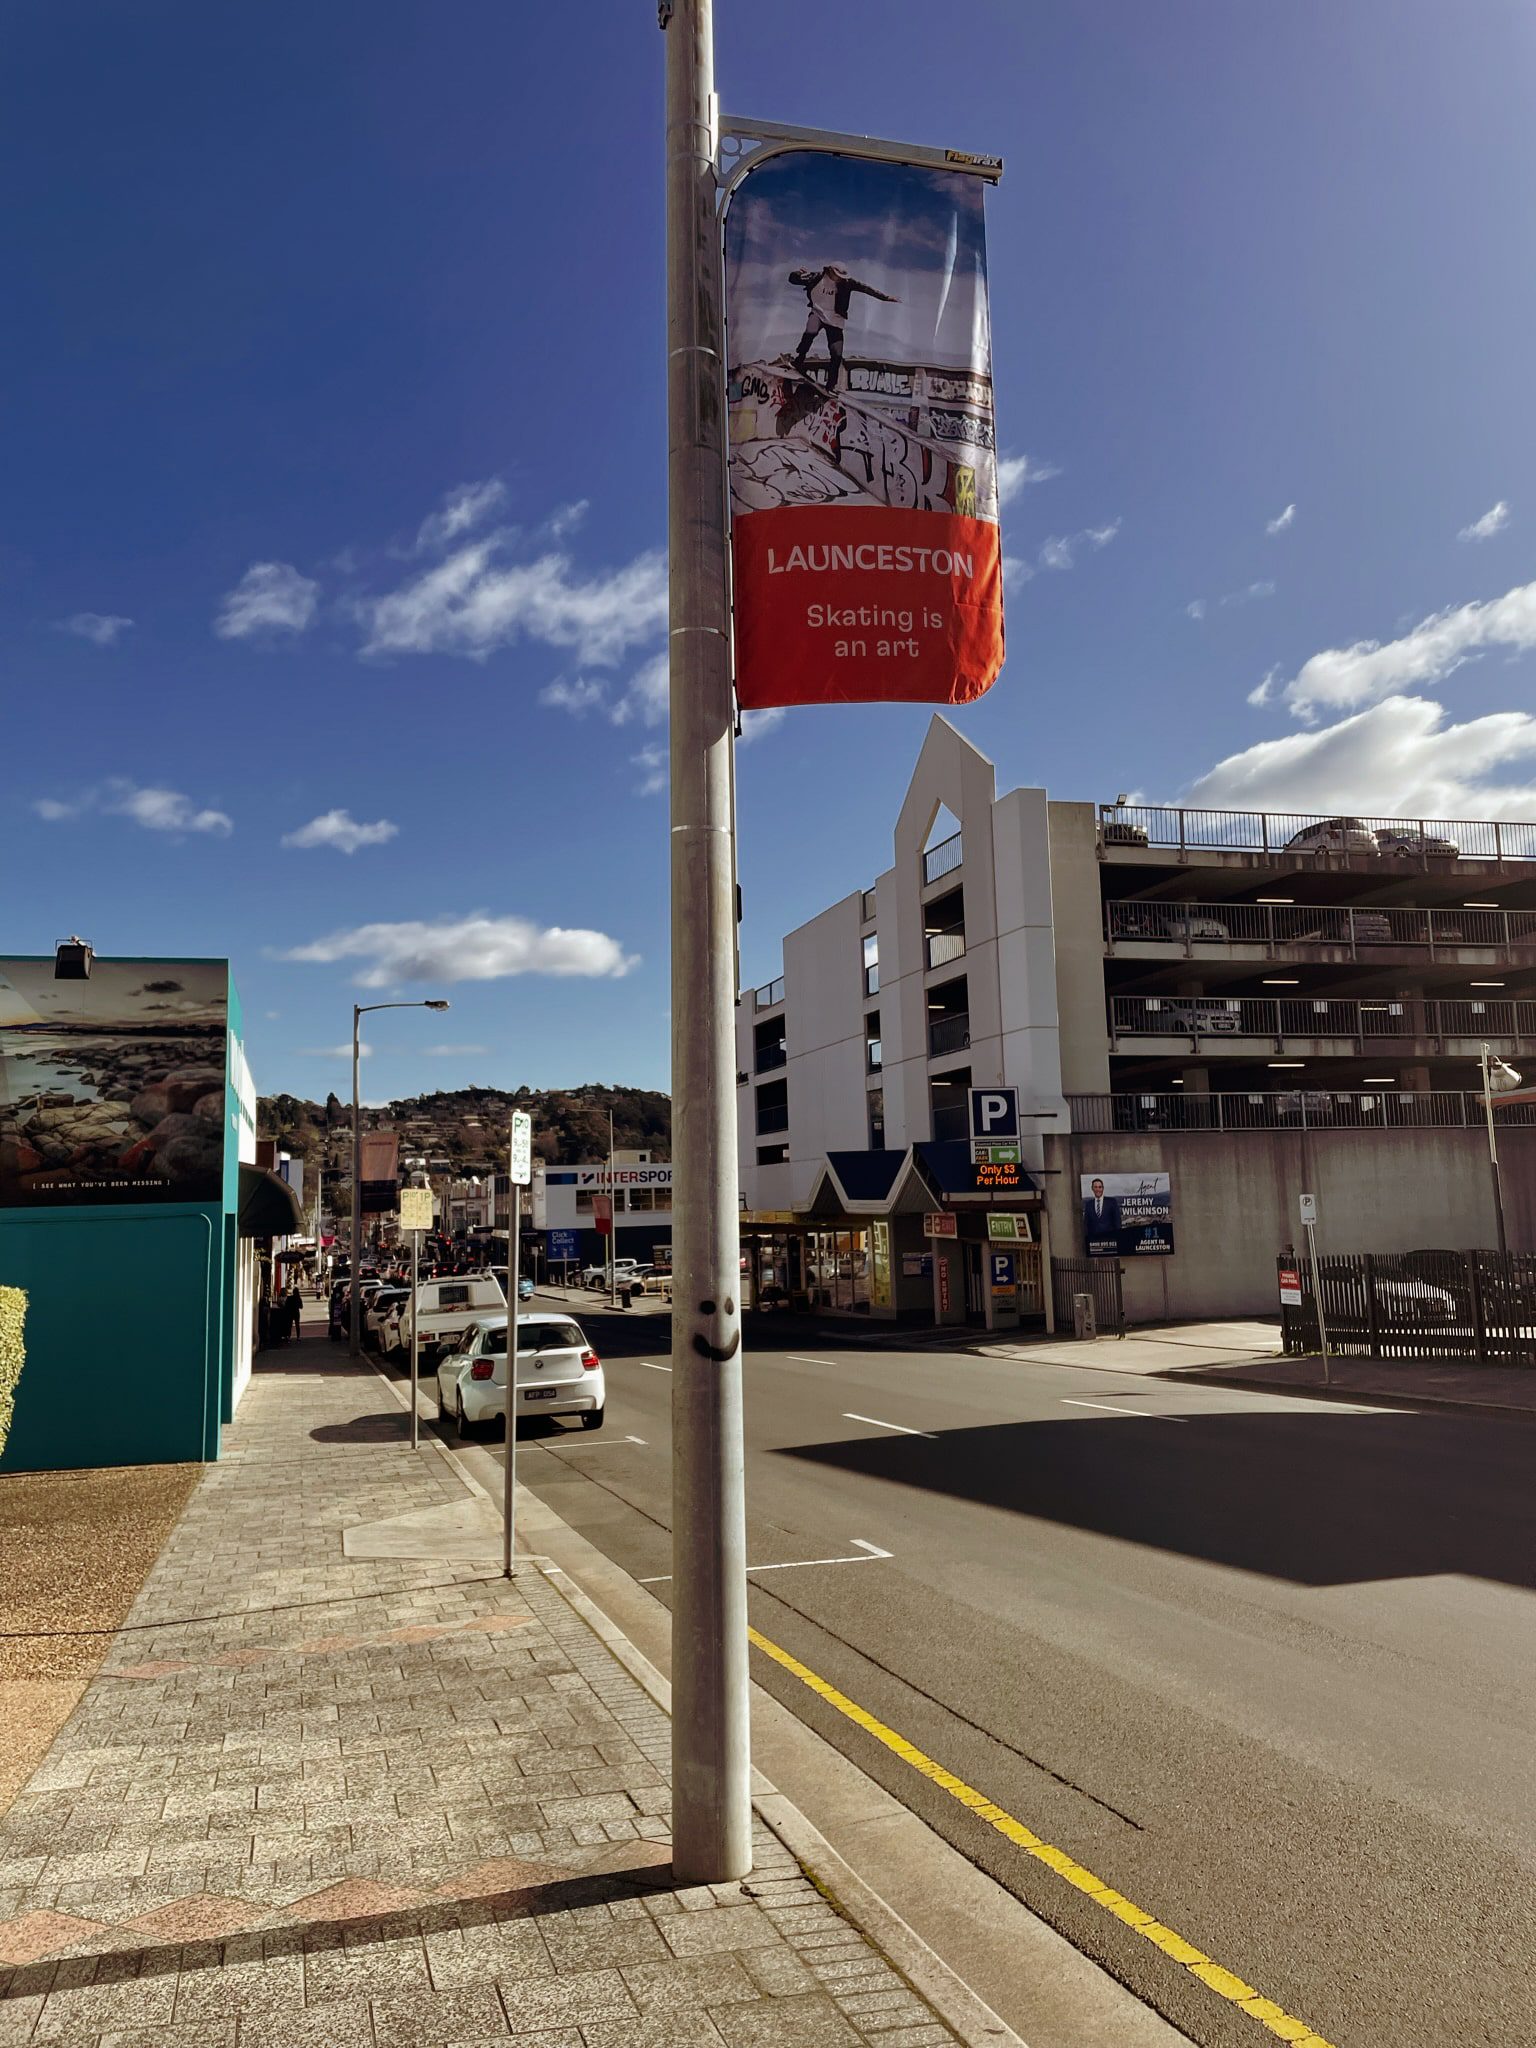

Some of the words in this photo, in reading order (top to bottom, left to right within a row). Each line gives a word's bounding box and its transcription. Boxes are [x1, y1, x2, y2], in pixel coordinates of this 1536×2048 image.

[768, 544, 974, 578] LAUNCESTON
[807, 604, 914, 633] Skating
[923, 608, 944, 630] is
[834, 640, 868, 658] an
[877, 637, 920, 659] art
[981, 1095, 1008, 1132] P
[980, 1165, 1002, 1176] Only
[1004, 1164, 1015, 1174] $3
[977, 1176, 994, 1185] Per
[995, 1176, 1020, 1185] Hour
[1121, 1198, 1154, 1206] JEREMY
[1122, 1207, 1169, 1216] WILKINSON
[991, 1220, 1012, 1233] ENTRY
[1145, 1227, 1160, 1239] #1
[552, 1237, 575, 1245] Collect
[995, 1257, 1009, 1275] P
[940, 1281, 949, 1311] ENTRY
